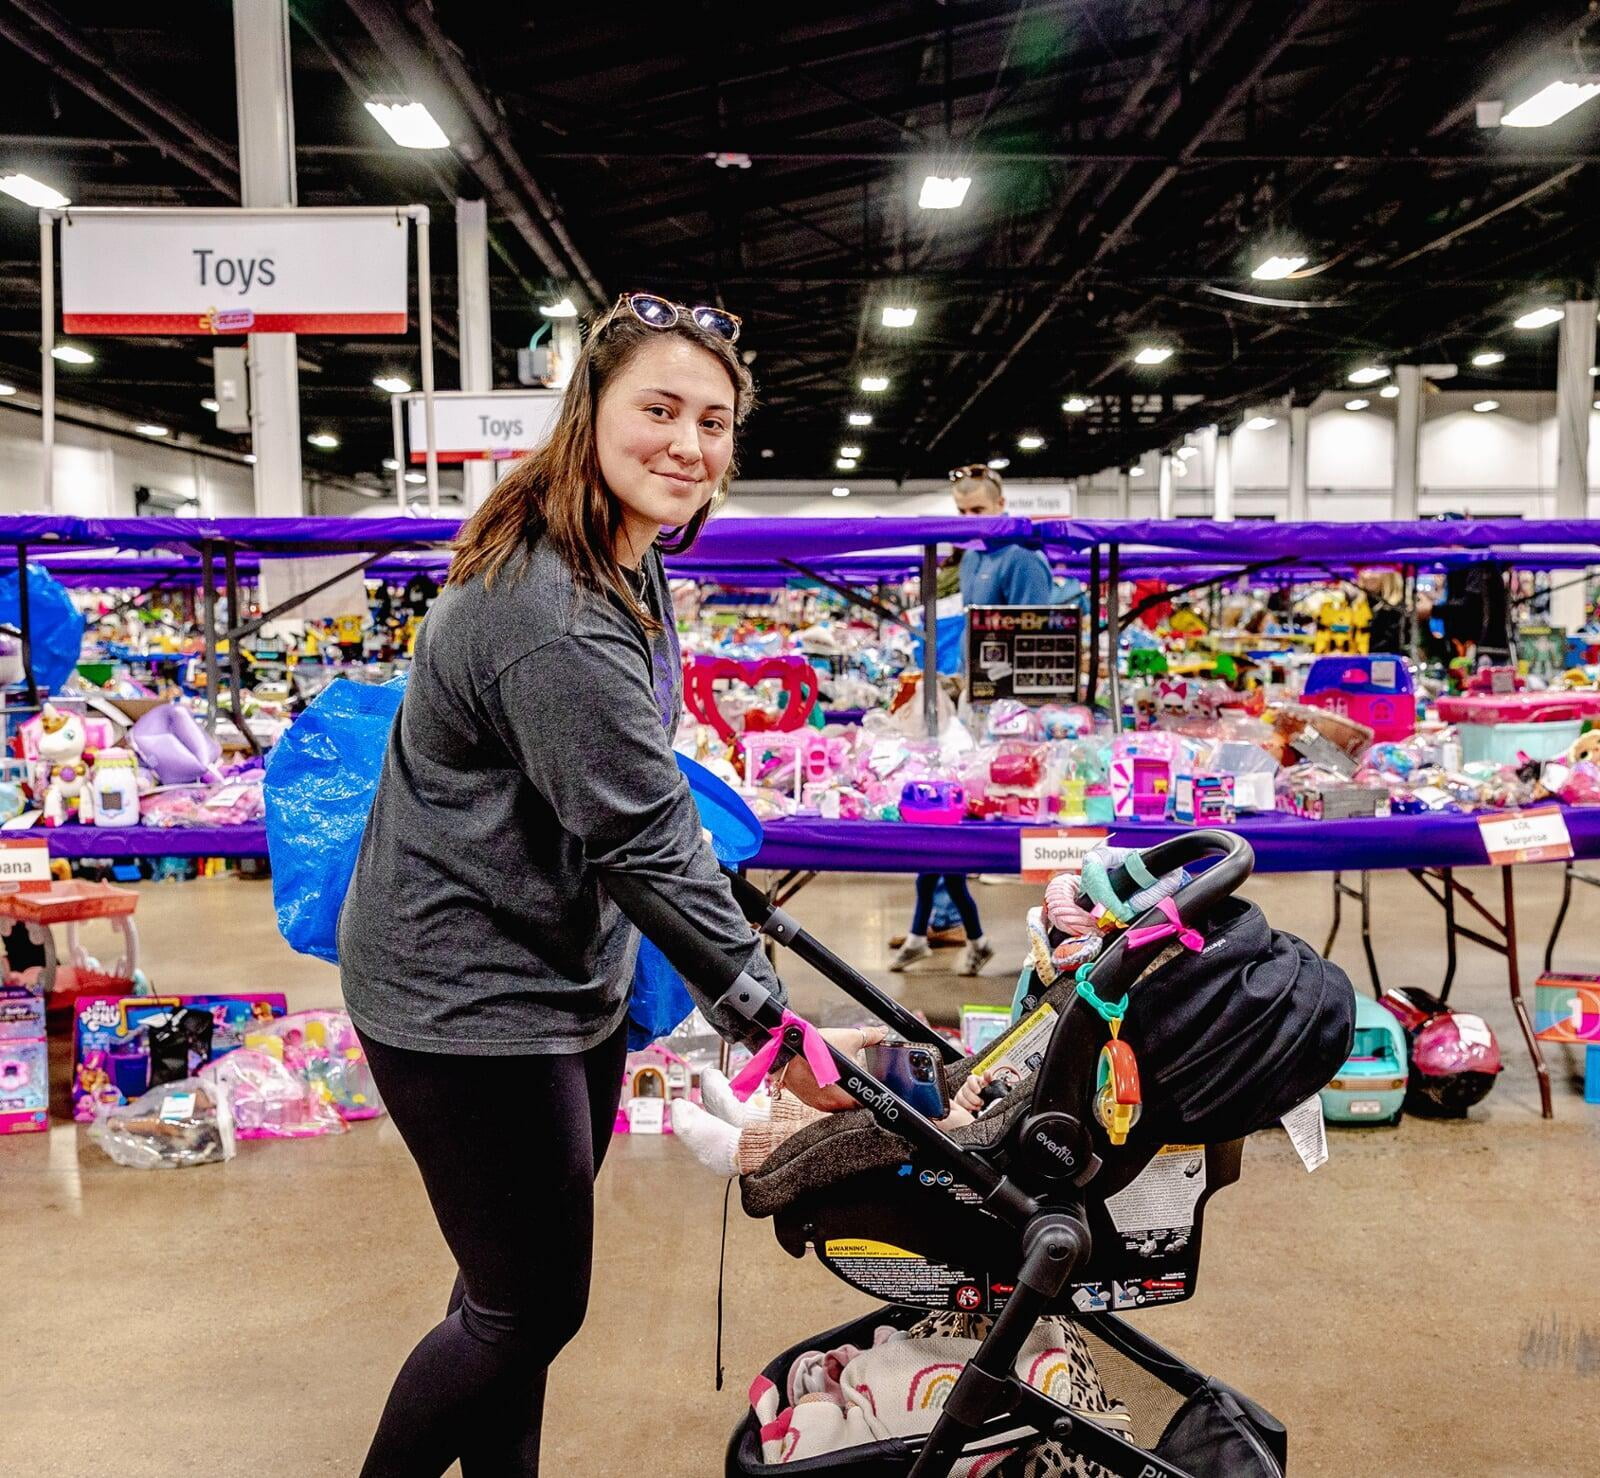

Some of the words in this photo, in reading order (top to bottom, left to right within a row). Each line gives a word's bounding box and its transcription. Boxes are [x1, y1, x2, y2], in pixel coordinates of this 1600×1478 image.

[192, 249, 276, 295] Toys
[478, 415, 524, 440] Toys
[0, 862, 32, 874] ana
[847, 1076, 899, 1121] evenflo
[1036, 1131, 1075, 1167] evenflo
